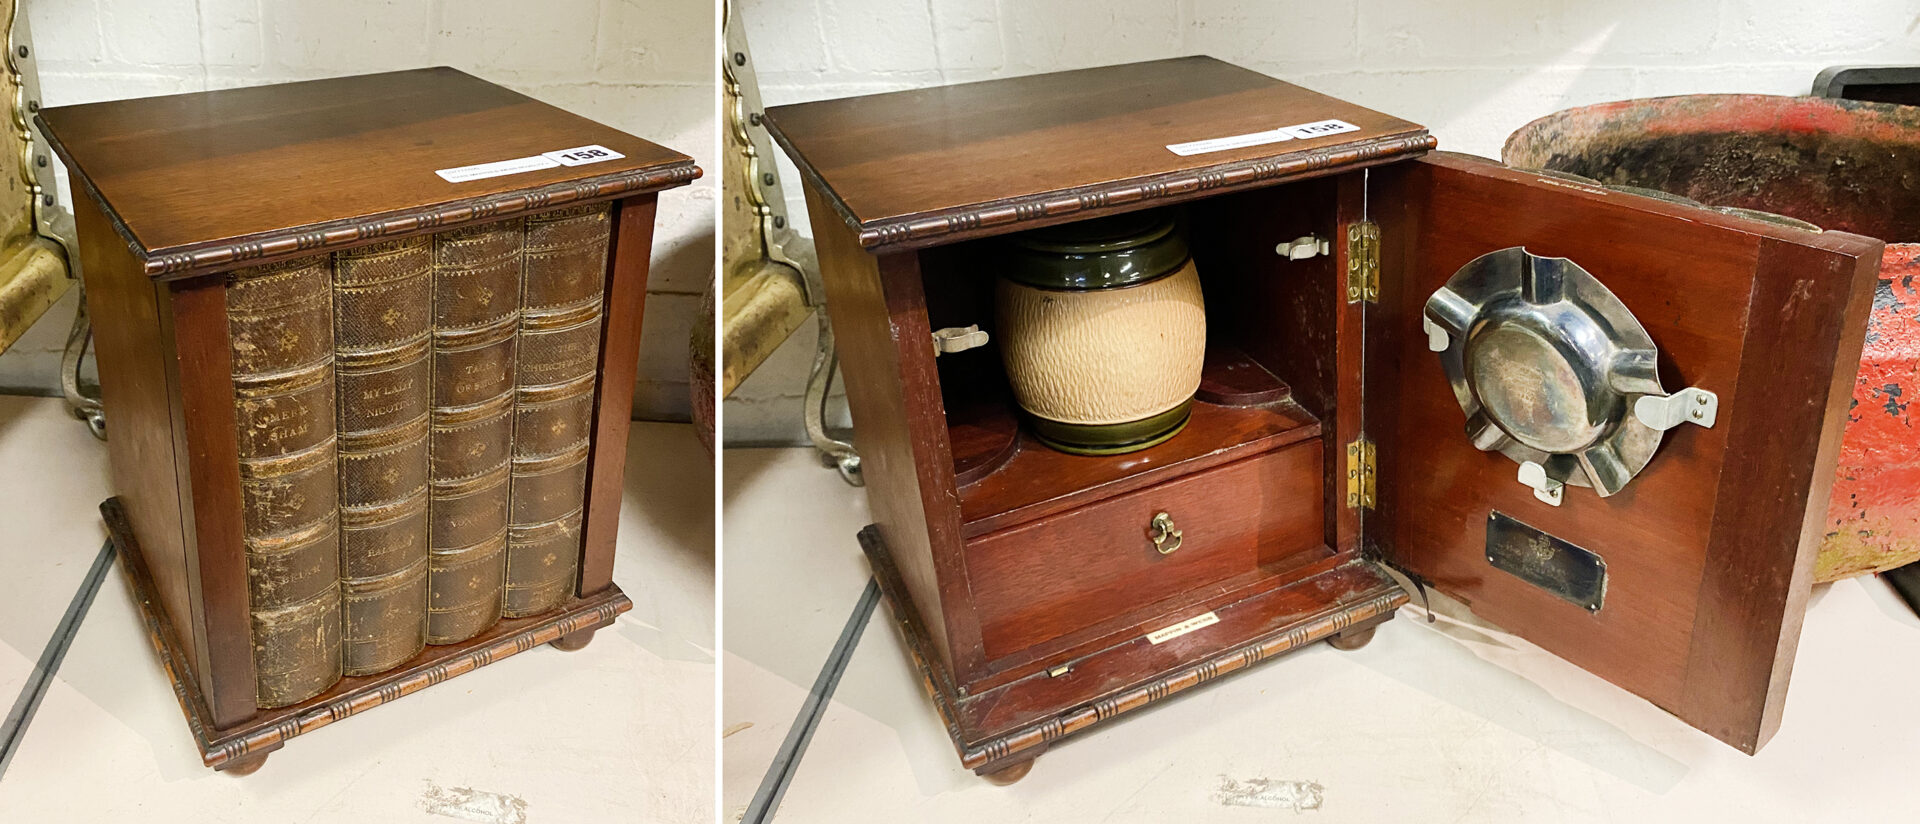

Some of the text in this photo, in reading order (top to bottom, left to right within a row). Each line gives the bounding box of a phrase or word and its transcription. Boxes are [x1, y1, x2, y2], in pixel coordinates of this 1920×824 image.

[1296, 122, 1345, 136] 158
[561, 148, 609, 163] 158
[363, 386, 382, 400] MY
